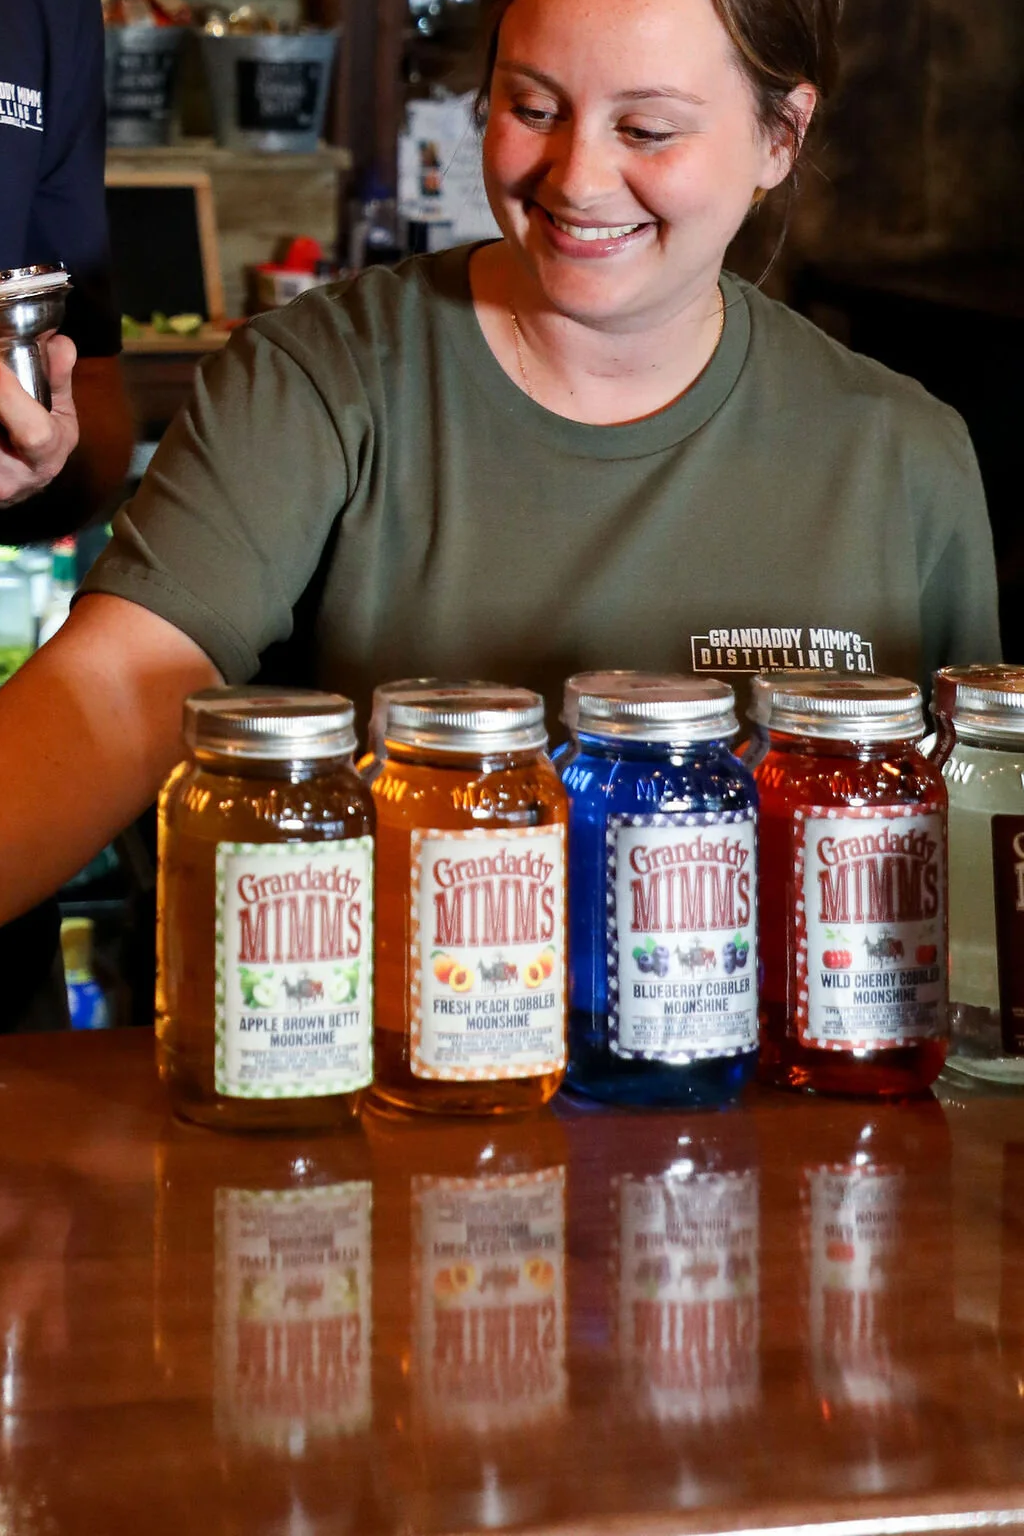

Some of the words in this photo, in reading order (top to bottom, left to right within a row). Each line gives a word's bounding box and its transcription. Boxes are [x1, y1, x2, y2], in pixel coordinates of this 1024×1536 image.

[709, 628, 803, 649] GRANDADDY
[809, 628, 863, 653] MIMM'S
[701, 648, 834, 668] DISTILLING
[846, 654, 872, 672] CO.
[629, 833, 749, 875] Grandaddy
[816, 825, 938, 866] Grandaddy
[433, 848, 554, 889] Grandaddy
[237, 862, 361, 904] Grandaddy
[817, 856, 938, 924] MIMMS
[629, 866, 750, 933] MIMMS
[433, 879, 555, 947] MIMMS
[238, 894, 361, 964] MIMMS
[633, 983, 703, 999] BLUEBERRY
[706, 978, 750, 996] COBBLER
[820, 973, 851, 989] WILD
[854, 972, 896, 988] CHERRY
[433, 999, 471, 1015] FRESH
[475, 999, 510, 1014] PEACH
[513, 993, 555, 1012] COBBLER
[664, 997, 729, 1014] MOONSHINE
[853, 986, 916, 1004] MOONSHINE
[239, 1016, 278, 1032] APPLE
[283, 1015, 325, 1031] BROWN
[329, 1011, 360, 1027] BETTY
[466, 1013, 530, 1031] MOONSHINE
[270, 1030, 335, 1048] MOONSHINE
